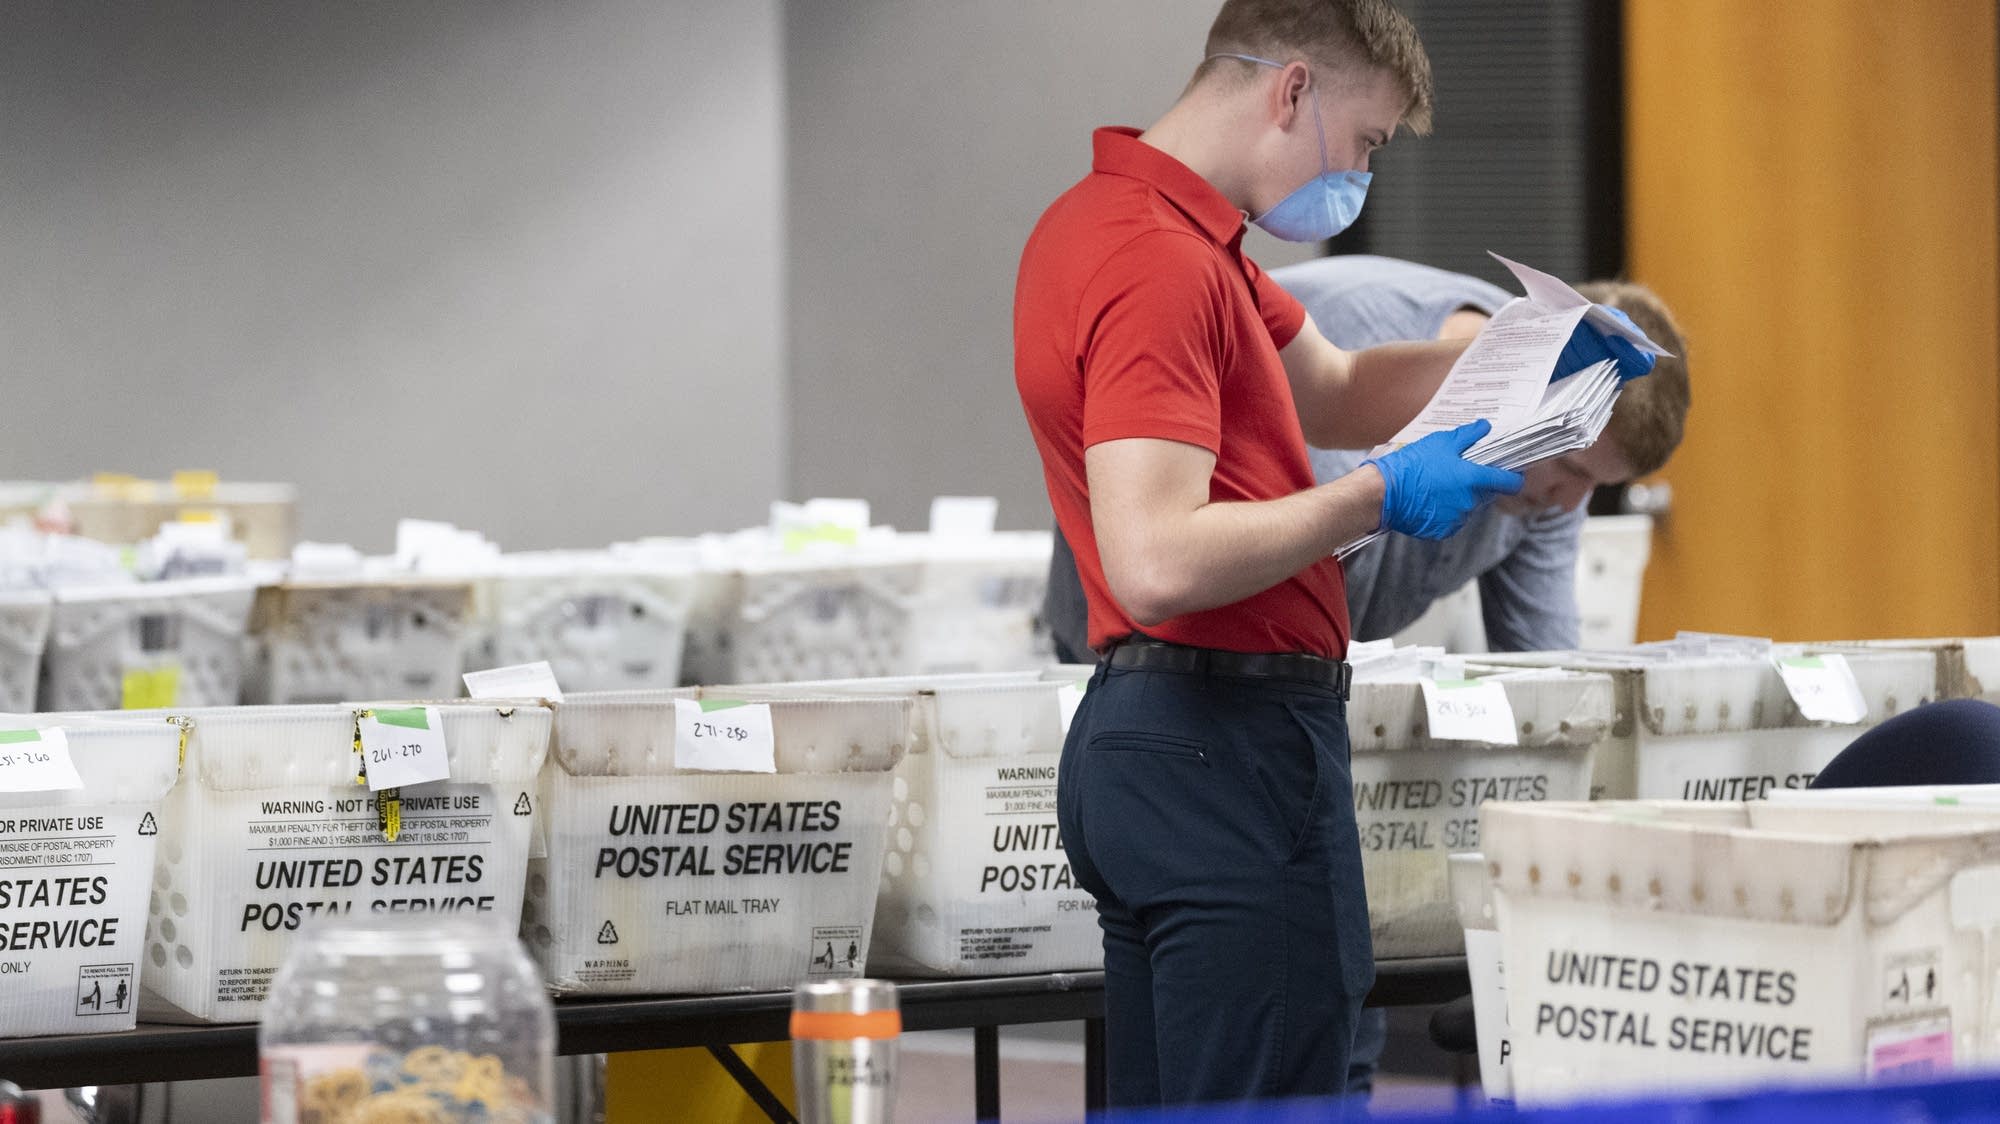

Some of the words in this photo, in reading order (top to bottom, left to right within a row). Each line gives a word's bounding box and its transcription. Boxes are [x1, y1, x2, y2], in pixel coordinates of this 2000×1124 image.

[998, 767, 1056, 781] WARNING
[986, 789, 1020, 799] MAXIMUM
[1021, 788, 1053, 798] PENALTY
[1448, 775, 1549, 807] STATES
[262, 800, 324, 814] WARNING
[336, 799, 362, 812] NOT
[400, 797, 450, 811] PRIVATE
[454, 796, 480, 809] USE
[1028, 801, 1043, 810] FINE
[20, 818, 73, 832] PRIVATE
[77, 816, 104, 830] USE
[249, 824, 286, 833] MAXIMUM
[287, 824, 320, 833] PENALTY
[323, 823, 340, 832] FOR
[341, 822, 363, 831] THEFT
[365, 822, 377, 830] OR
[408, 821, 420, 829] OF
[420, 819, 448, 828] POSTAL
[450, 818, 491, 828] PROPERTY
[609, 803, 720, 836] UNITED
[725, 800, 842, 833] STATES
[269, 837, 292, 847] $1,000
[293, 837, 310, 846] FINE
[311, 836, 328, 845] AND
[334, 835, 360, 844] YEARS
[433, 832, 449, 841] USC
[450, 831, 469, 841] 1707)
[993, 824, 1065, 852] UNIT
[1361, 821, 1434, 851] STAL
[1, 843, 29, 852] MISUSE
[31, 842, 42, 851] OF
[43, 841, 72, 850] POSTAL
[74, 839, 115, 849] PROPERTY
[43, 855, 55, 865] (18
[55, 854, 72, 864] USC
[74, 853, 93, 863] 1707)
[595, 845, 716, 878] POSTAL
[723, 842, 853, 875] SERVICE
[255, 858, 363, 890] UNITED
[371, 854, 484, 886] STATES
[0, 876, 108, 909] STATES
[666, 900, 701, 916] FLAT
[705, 899, 738, 915] MAIL
[741, 898, 780, 914] TRAY
[1057, 901, 1079, 912] FOR
[1082, 901, 1097, 911] MA
[0, 918, 119, 951] SERVICE
[1, 961, 31, 974] ONLY
[219, 968, 242, 976] RETURN
[584, 960, 629, 968] WARNING
[1546, 949, 1660, 993] UNITED
[1669, 962, 1798, 1006] STATES
[1536, 1002, 1657, 1048] POSTAL
[1667, 1015, 1814, 1062] SERVICE
